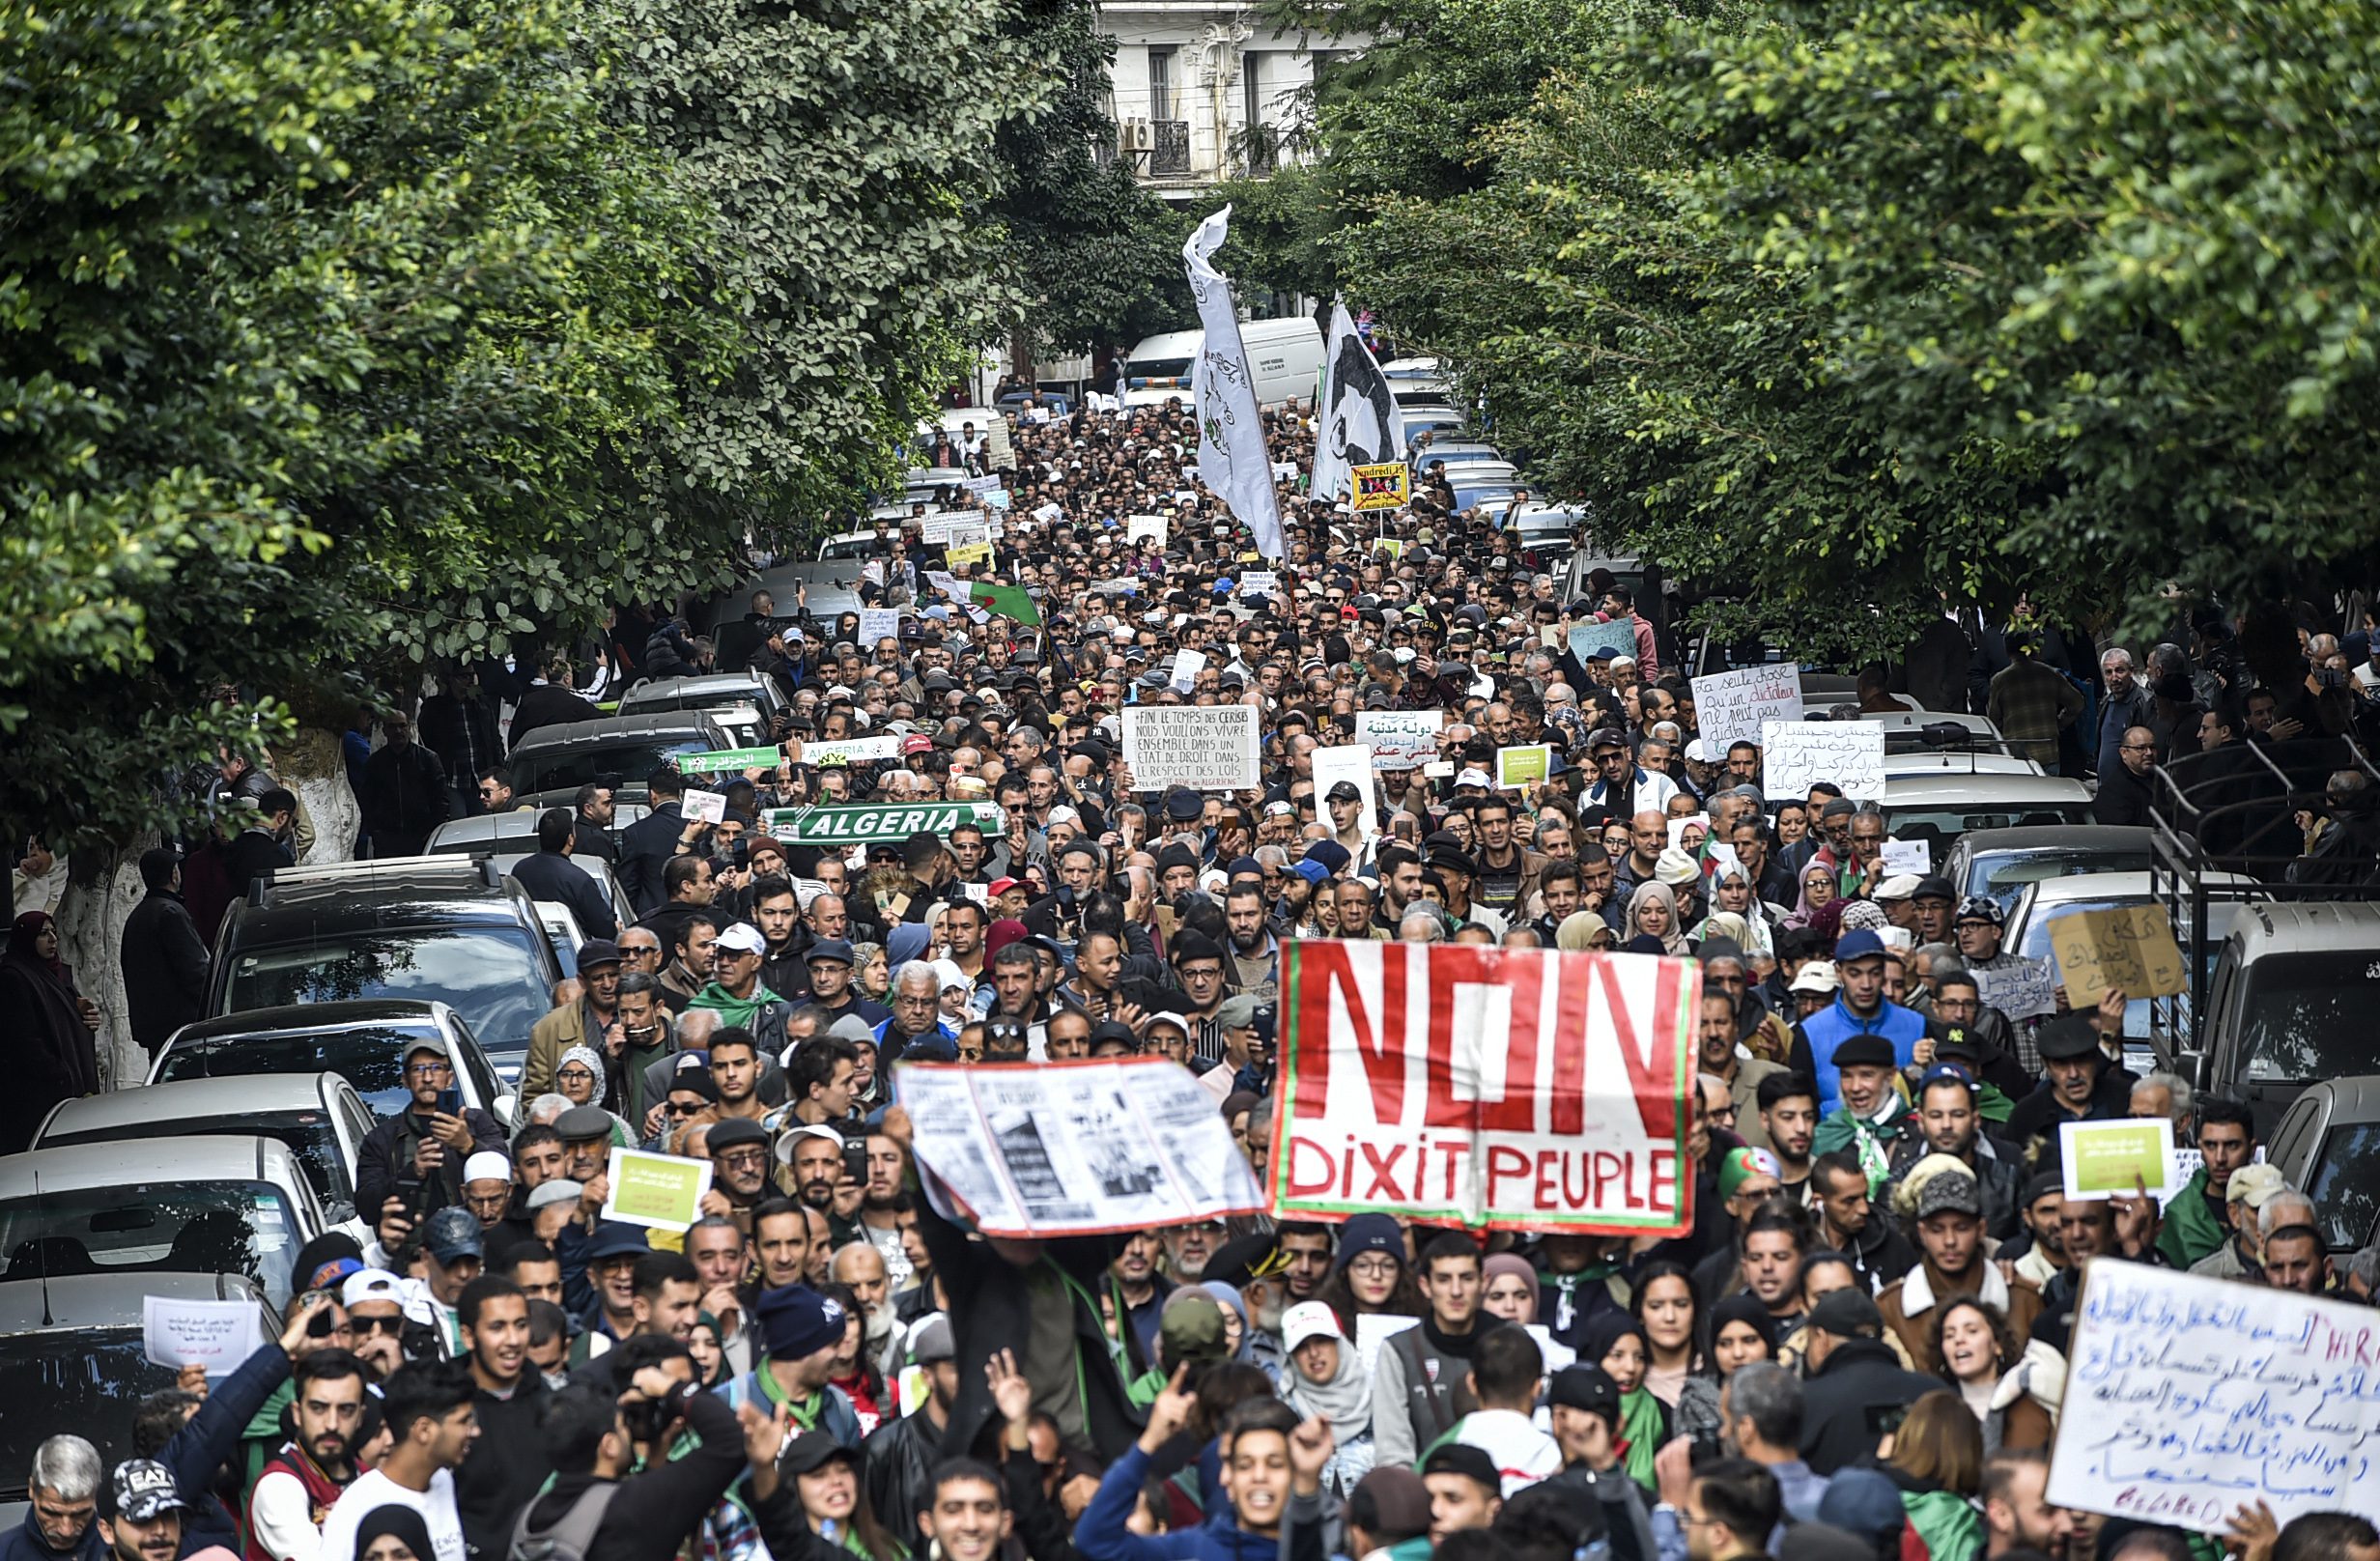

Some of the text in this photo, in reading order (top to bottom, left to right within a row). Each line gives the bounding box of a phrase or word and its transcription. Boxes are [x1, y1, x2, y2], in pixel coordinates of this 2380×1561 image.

[1695, 666, 1793, 694] La seule chose
[1161, 711, 1169, 724] LE
[1205, 713, 1216, 724] DES
[1758, 705, 1781, 724] pas
[1136, 725, 1159, 737] NOUS
[1214, 724, 1245, 737] VIVRE
[1402, 721, 1431, 737] دولة
[1138, 738, 1234, 751] ENSEMBLE DANS UN
[714, 753, 753, 770] الجزائر
[1138, 751, 1240, 763] ETAT DE DROIT DANS
[1137, 764, 1241, 777] LE RESPECT DES LOIS
[806, 809, 959, 837] ALGERIA
[1293, 941, 1679, 1139] NON
[1488, 1145, 1676, 1211] PEUPLE
[2325, 1325, 2380, 1369] HiR
